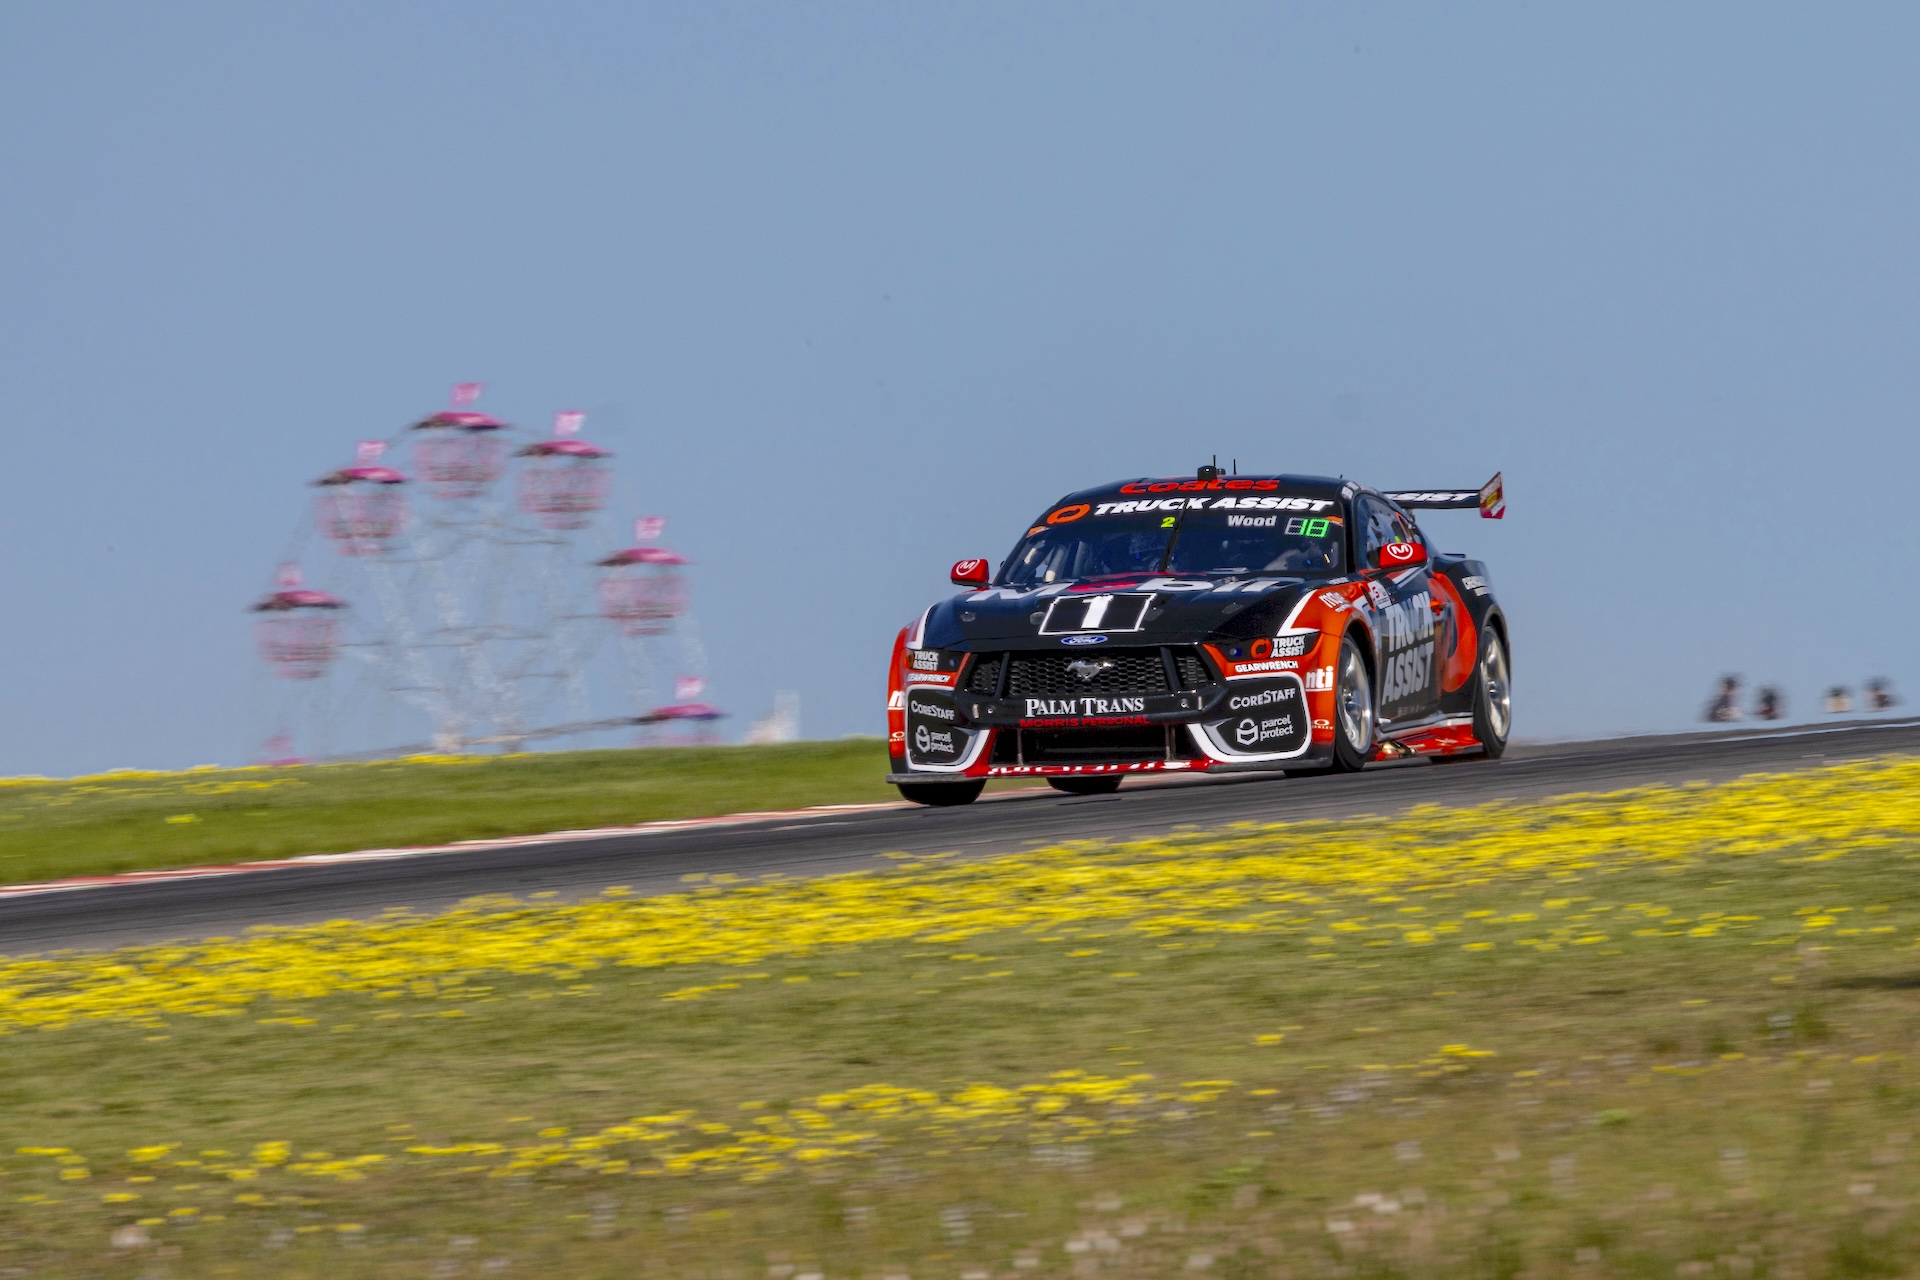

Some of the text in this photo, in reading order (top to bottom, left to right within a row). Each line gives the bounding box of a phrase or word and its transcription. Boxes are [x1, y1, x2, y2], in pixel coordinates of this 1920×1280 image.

[1120, 479, 1281, 494] Coates
[1093, 497, 1335, 515] TRUCK ASSIST
[1160, 516, 1176, 528] 2
[1228, 515, 1277, 527] Wood
[1081, 594, 1114, 629] 1
[1385, 590, 1435, 653] TRUCK
[1272, 635, 1305, 648] TRUCK
[914, 651, 939, 661] TRUCK
[1270, 645, 1305, 658] ASSIST
[913, 660, 938, 671] ASSIST
[1235, 660, 1299, 673] GEARWRENCH
[1305, 665, 1334, 689] nti
[1382, 641, 1434, 706] ASSIST
[1025, 697, 1145, 718] PALM TRANS
[1020, 716, 1150, 728] MORRIS PERSONAL
[1261, 714, 1292, 731] parcel
[930, 731, 952, 743] parcel
[1260, 724, 1294, 742] protect
[930, 741, 954, 753] protect
